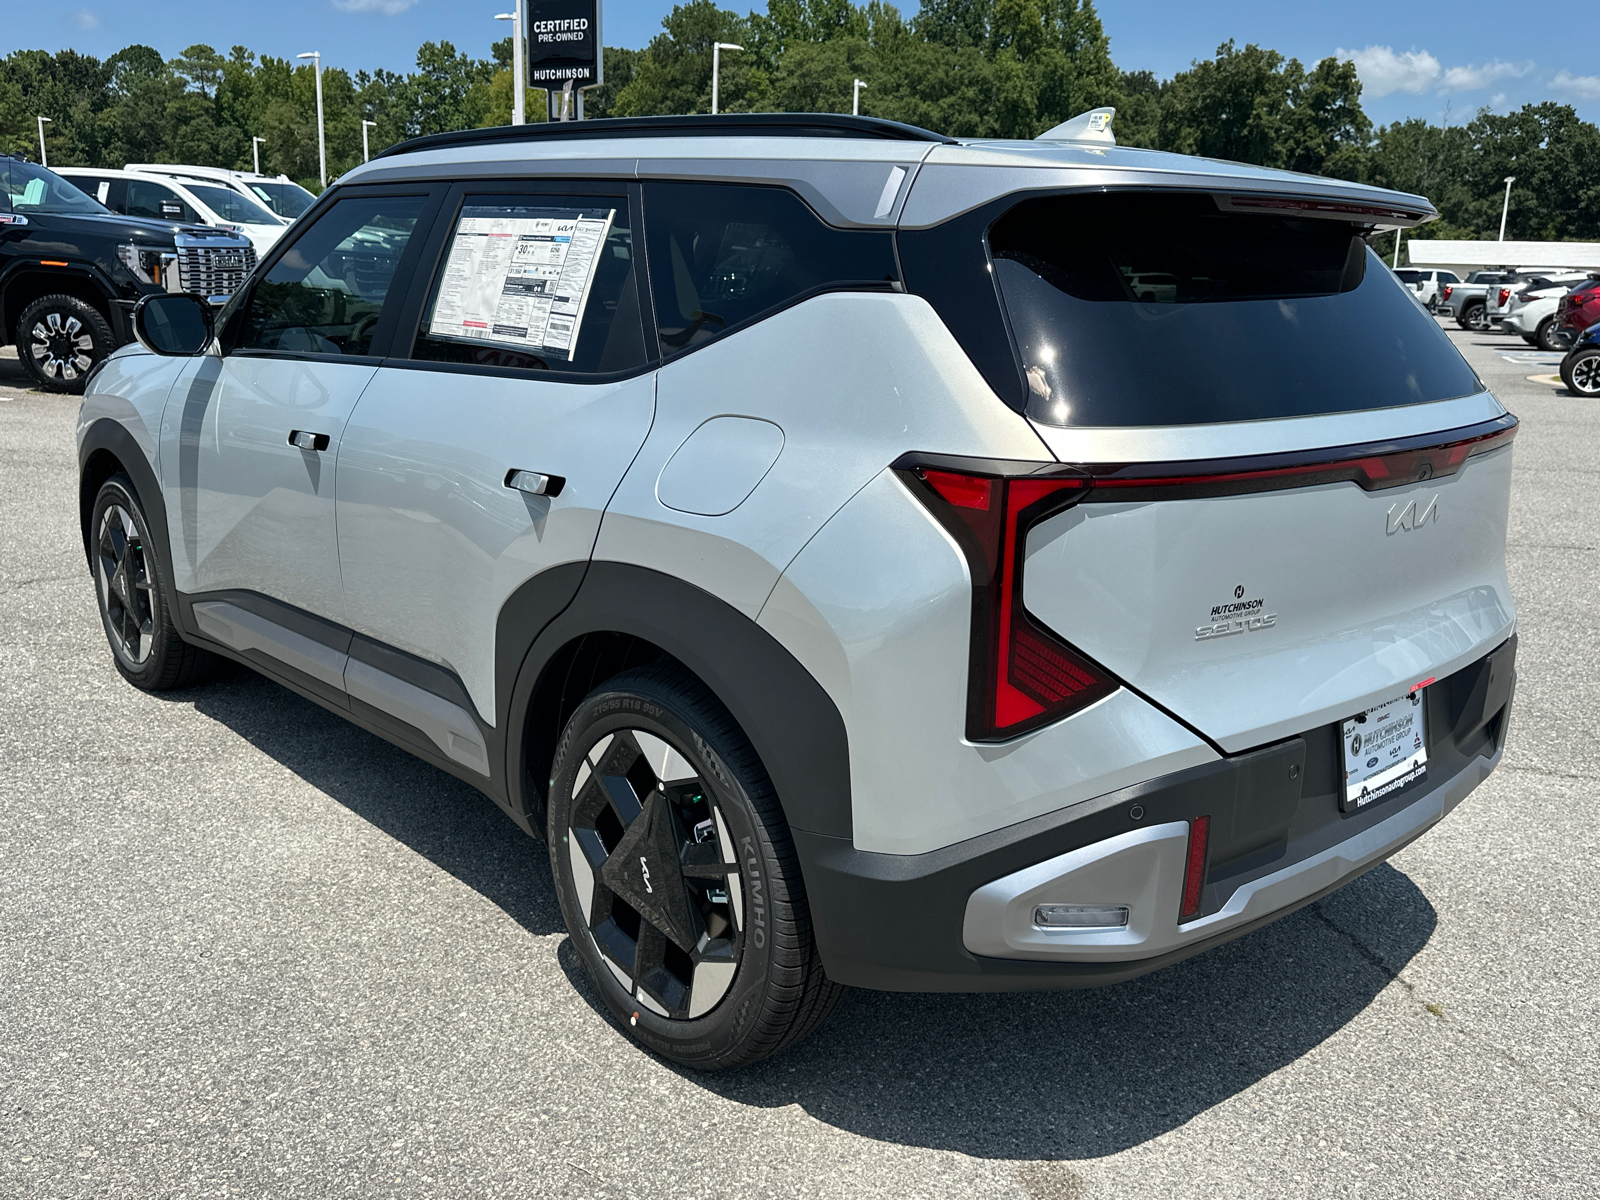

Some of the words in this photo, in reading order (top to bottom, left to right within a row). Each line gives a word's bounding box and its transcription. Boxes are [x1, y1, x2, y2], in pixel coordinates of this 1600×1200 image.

[533, 18, 589, 33] CERTIFIED
[538, 31, 584, 43] PRE-OWNED
[534, 67, 590, 80] HUTCHINSON
[518, 244, 528, 254] 30
[1386, 493, 1441, 536] KIA
[1210, 598, 1264, 616] HUTCHINSON
[1211, 612, 1243, 622] AUTOMOTIVE
[1244, 608, 1261, 617] GROUP
[1195, 613, 1278, 641] SELTOS
[622, 698, 641, 710] R18
[642, 703, 664, 718] 95V
[1363, 712, 1414, 748] HUTCHINSON
[1364, 734, 1396, 757] AUTOMOTIVE
[1395, 727, 1412, 741] GROUP
[1357, 765, 1427, 808] Hutchinsonautogroup.com
[740, 835, 766, 949] KUMHO
